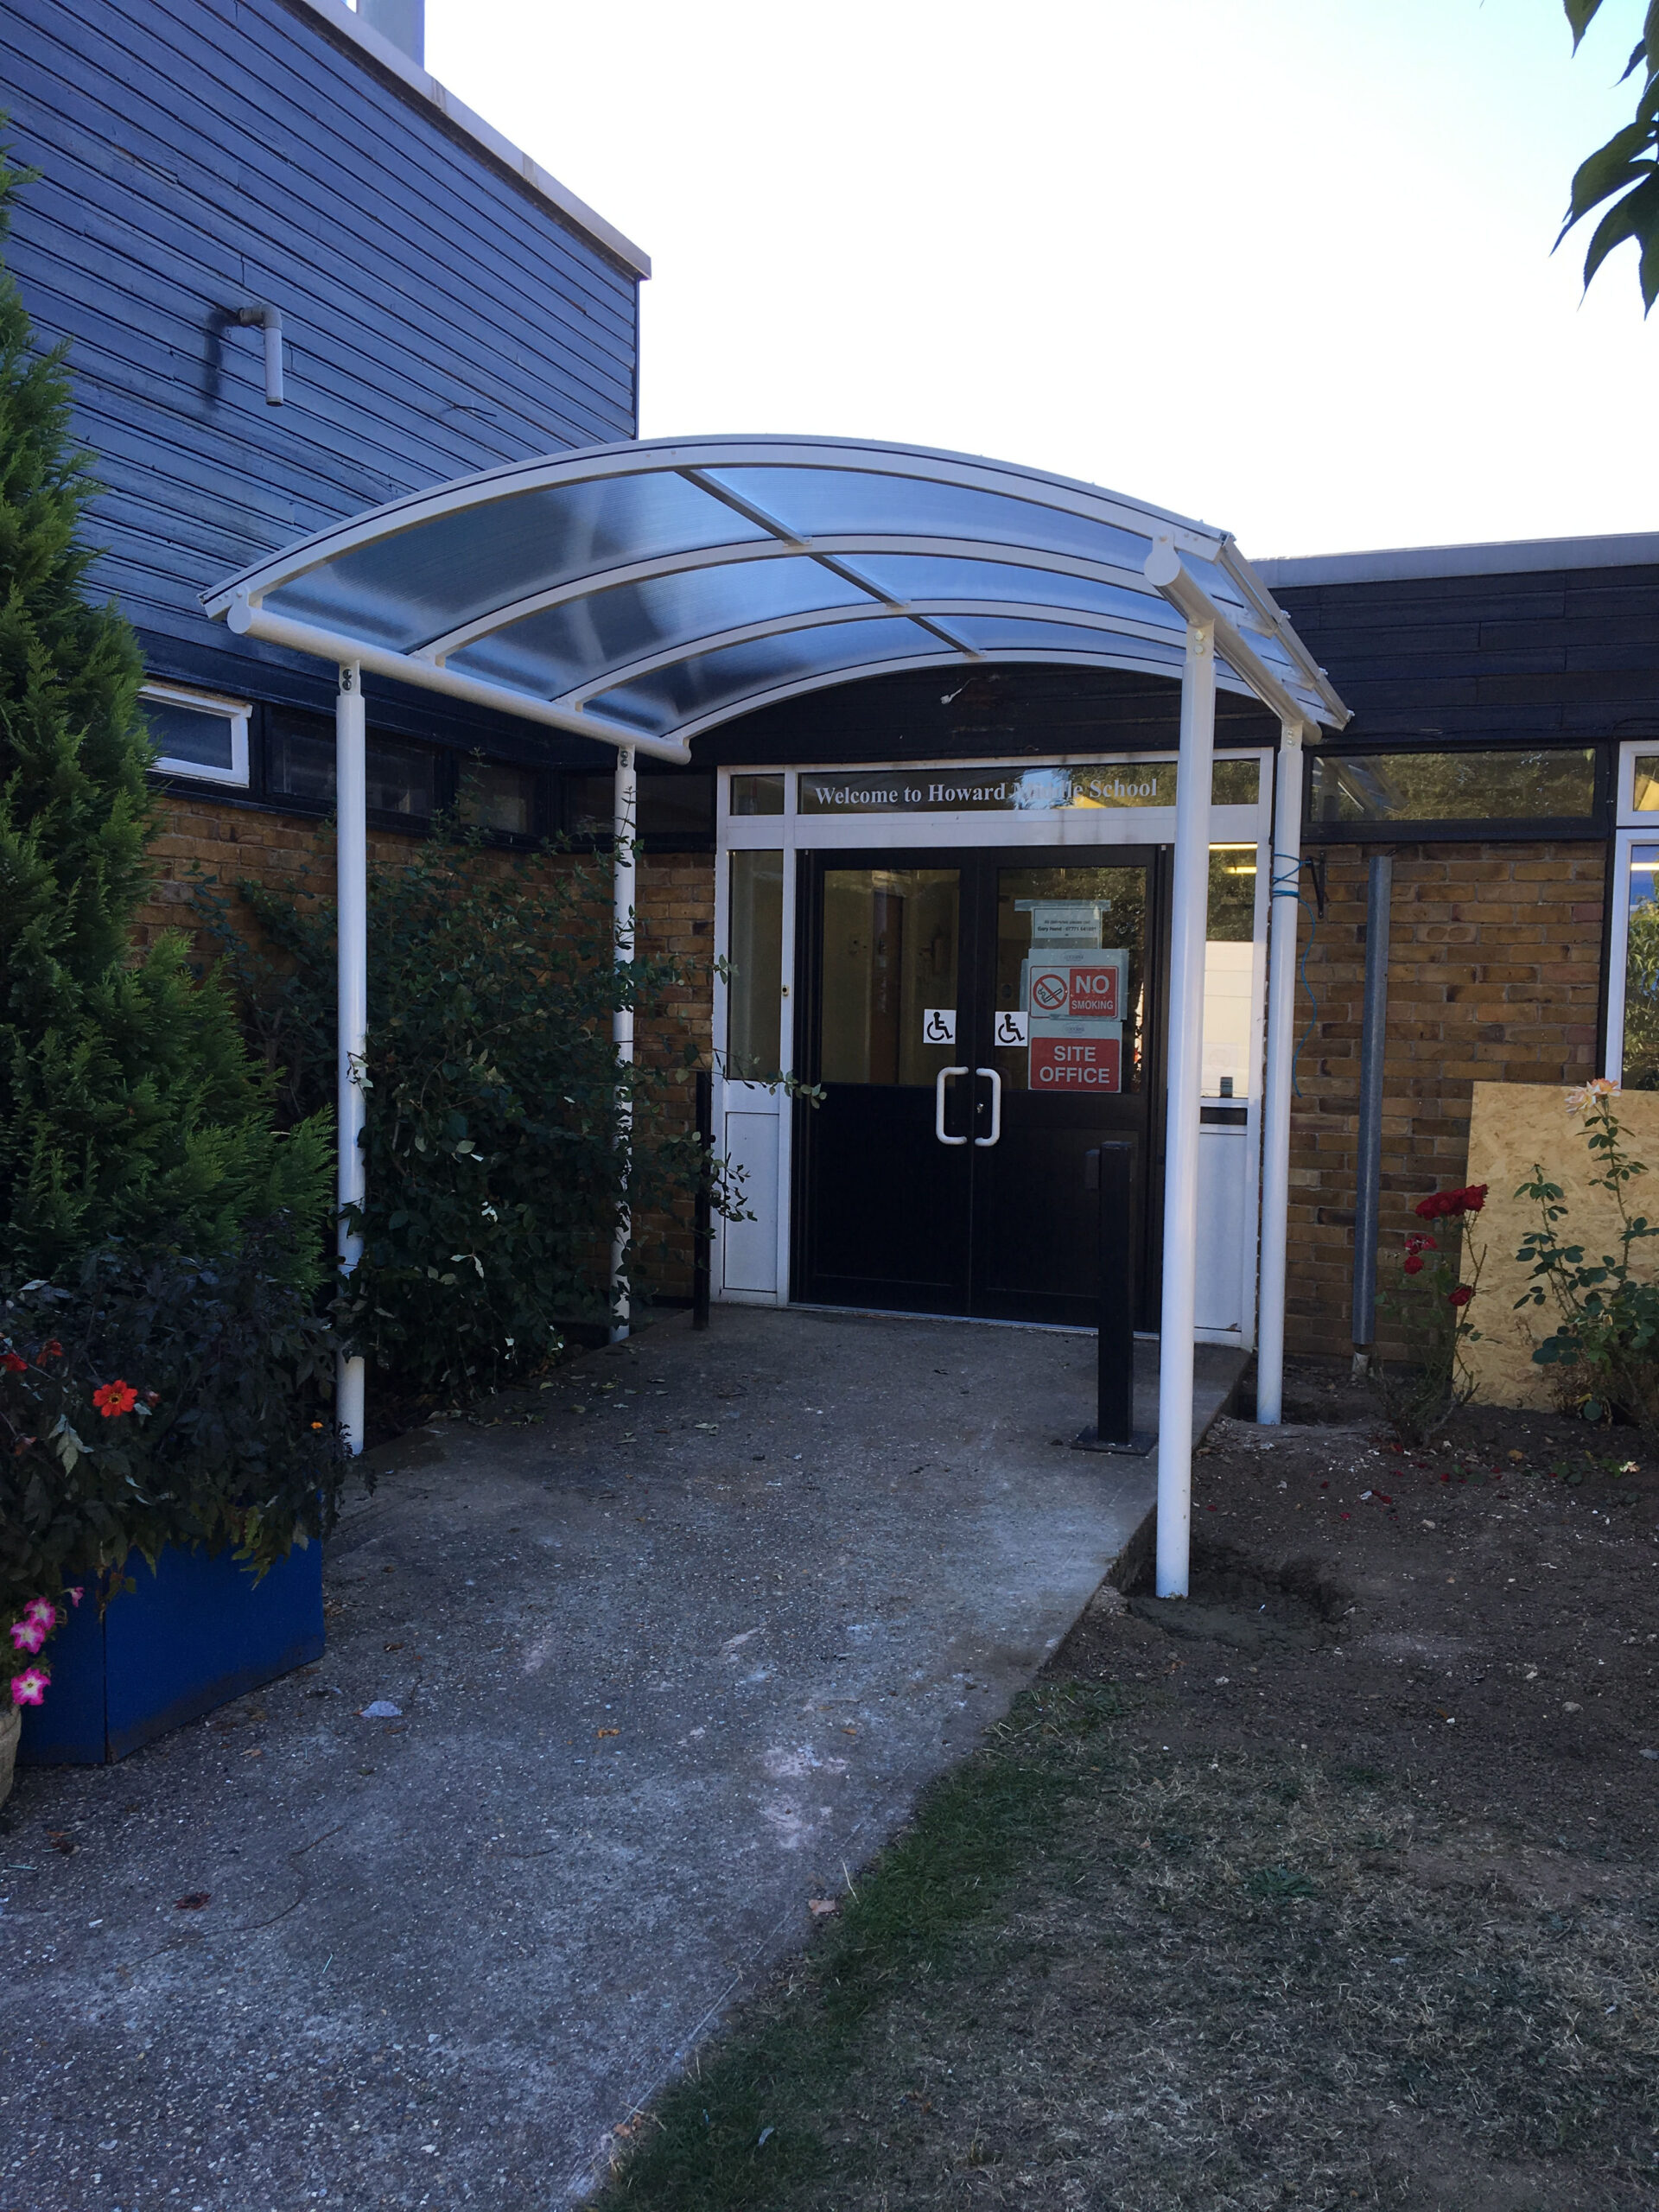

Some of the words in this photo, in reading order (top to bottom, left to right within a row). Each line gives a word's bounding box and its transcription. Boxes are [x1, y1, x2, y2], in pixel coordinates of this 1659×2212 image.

[816, 787, 898, 804] Welcome
[904, 786, 922, 802] to
[928, 783, 1006, 802] Howard
[1090, 778, 1157, 798] School
[1075, 975, 1109, 995] NO
[1071, 1000, 1114, 1010] SMOKING
[1053, 1045, 1096, 1062] SITE
[1039, 1065, 1110, 1084] OFFICE
